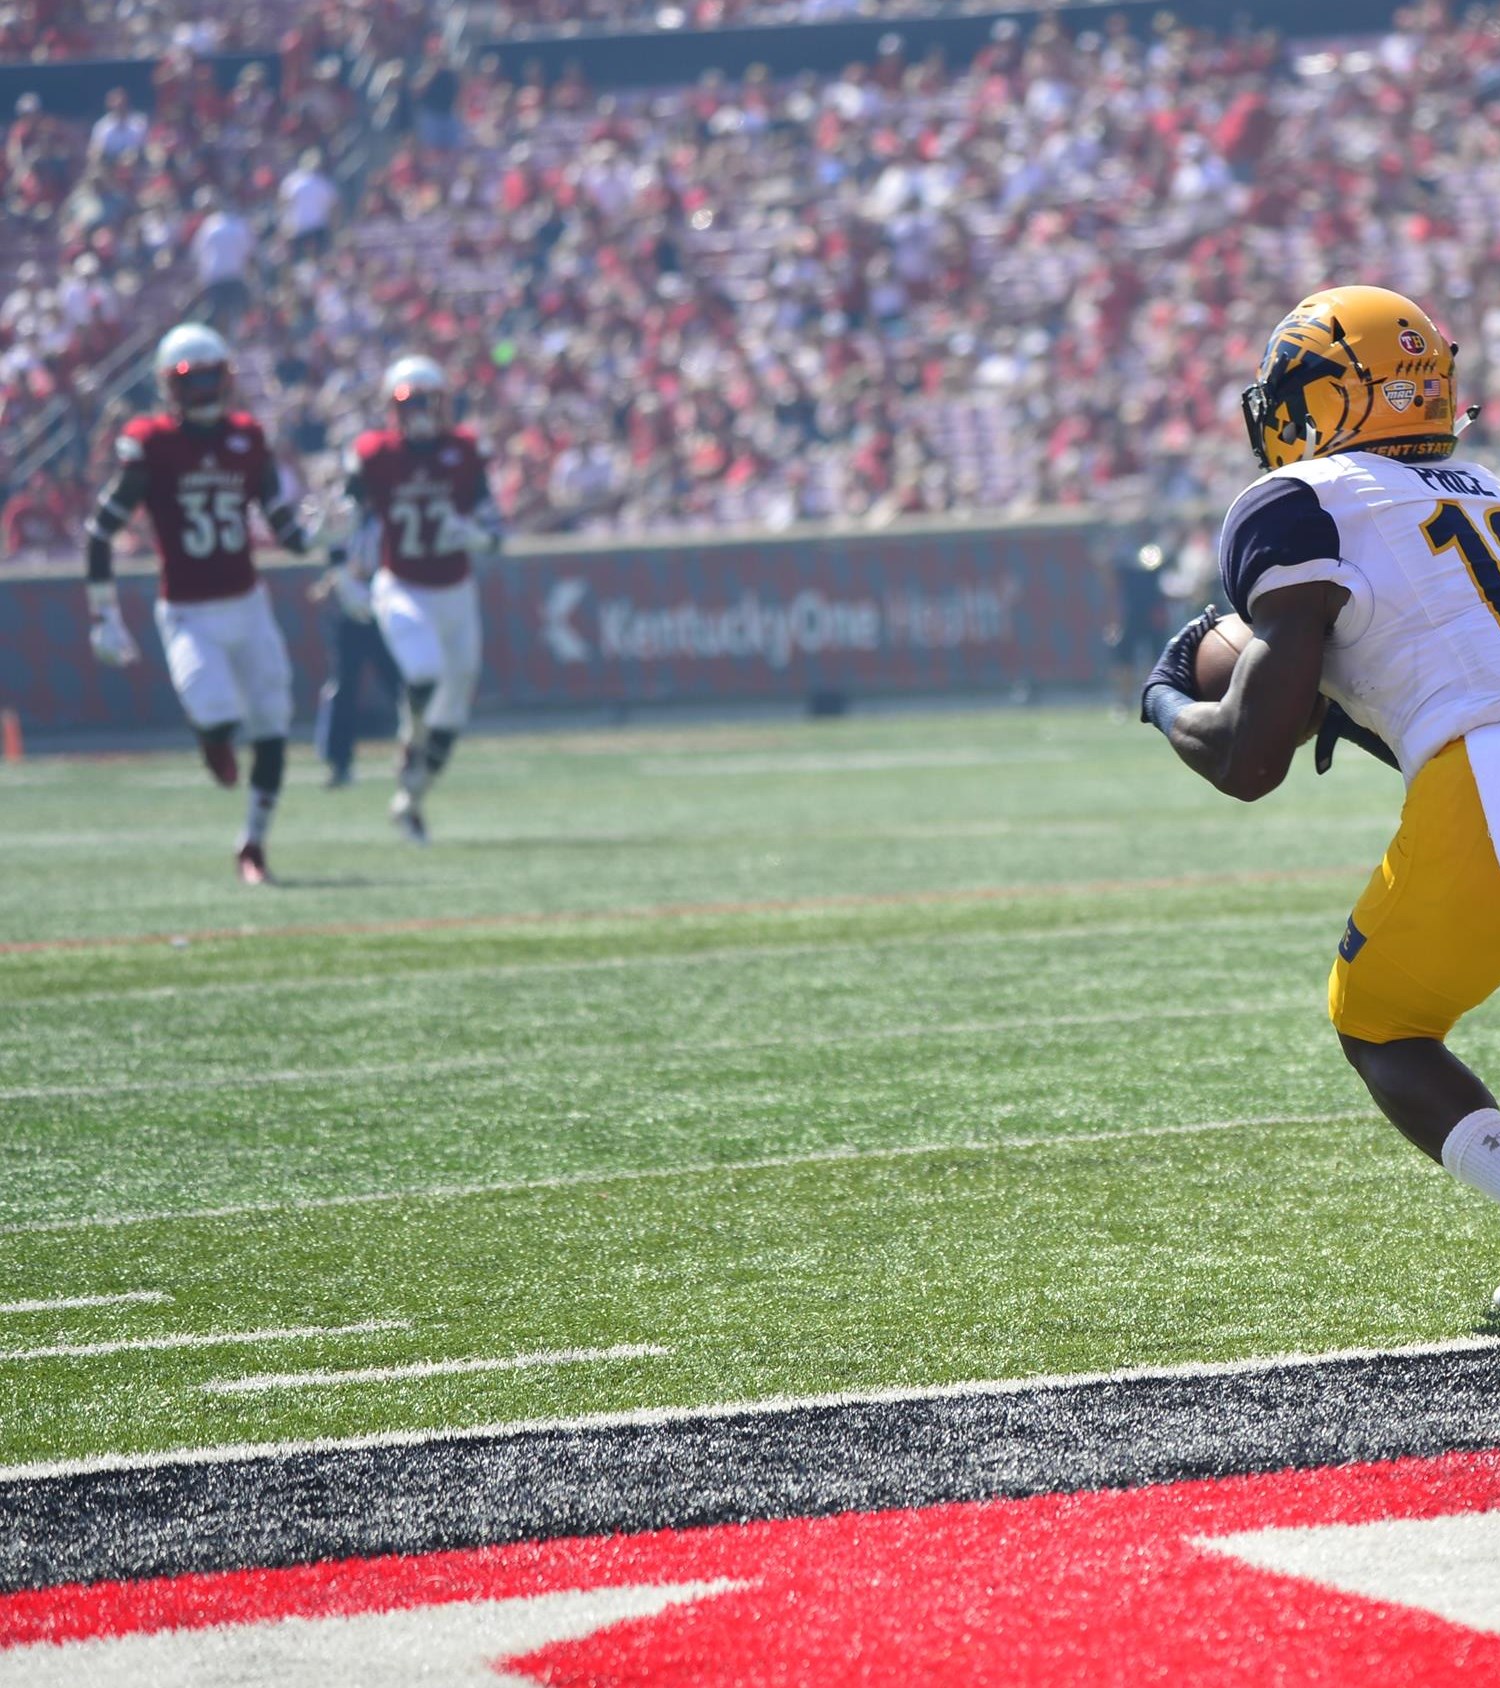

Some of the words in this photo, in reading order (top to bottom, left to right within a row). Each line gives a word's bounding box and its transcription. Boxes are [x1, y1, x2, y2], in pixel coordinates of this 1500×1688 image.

[1401, 335, 1425, 350] TH
[1386, 389, 1414, 399] MAC
[1404, 466, 1497, 497] PRICE
[177, 491, 247, 559] 35
[389, 500, 463, 559] 22
[602, 588, 878, 668] KentuckyOne
